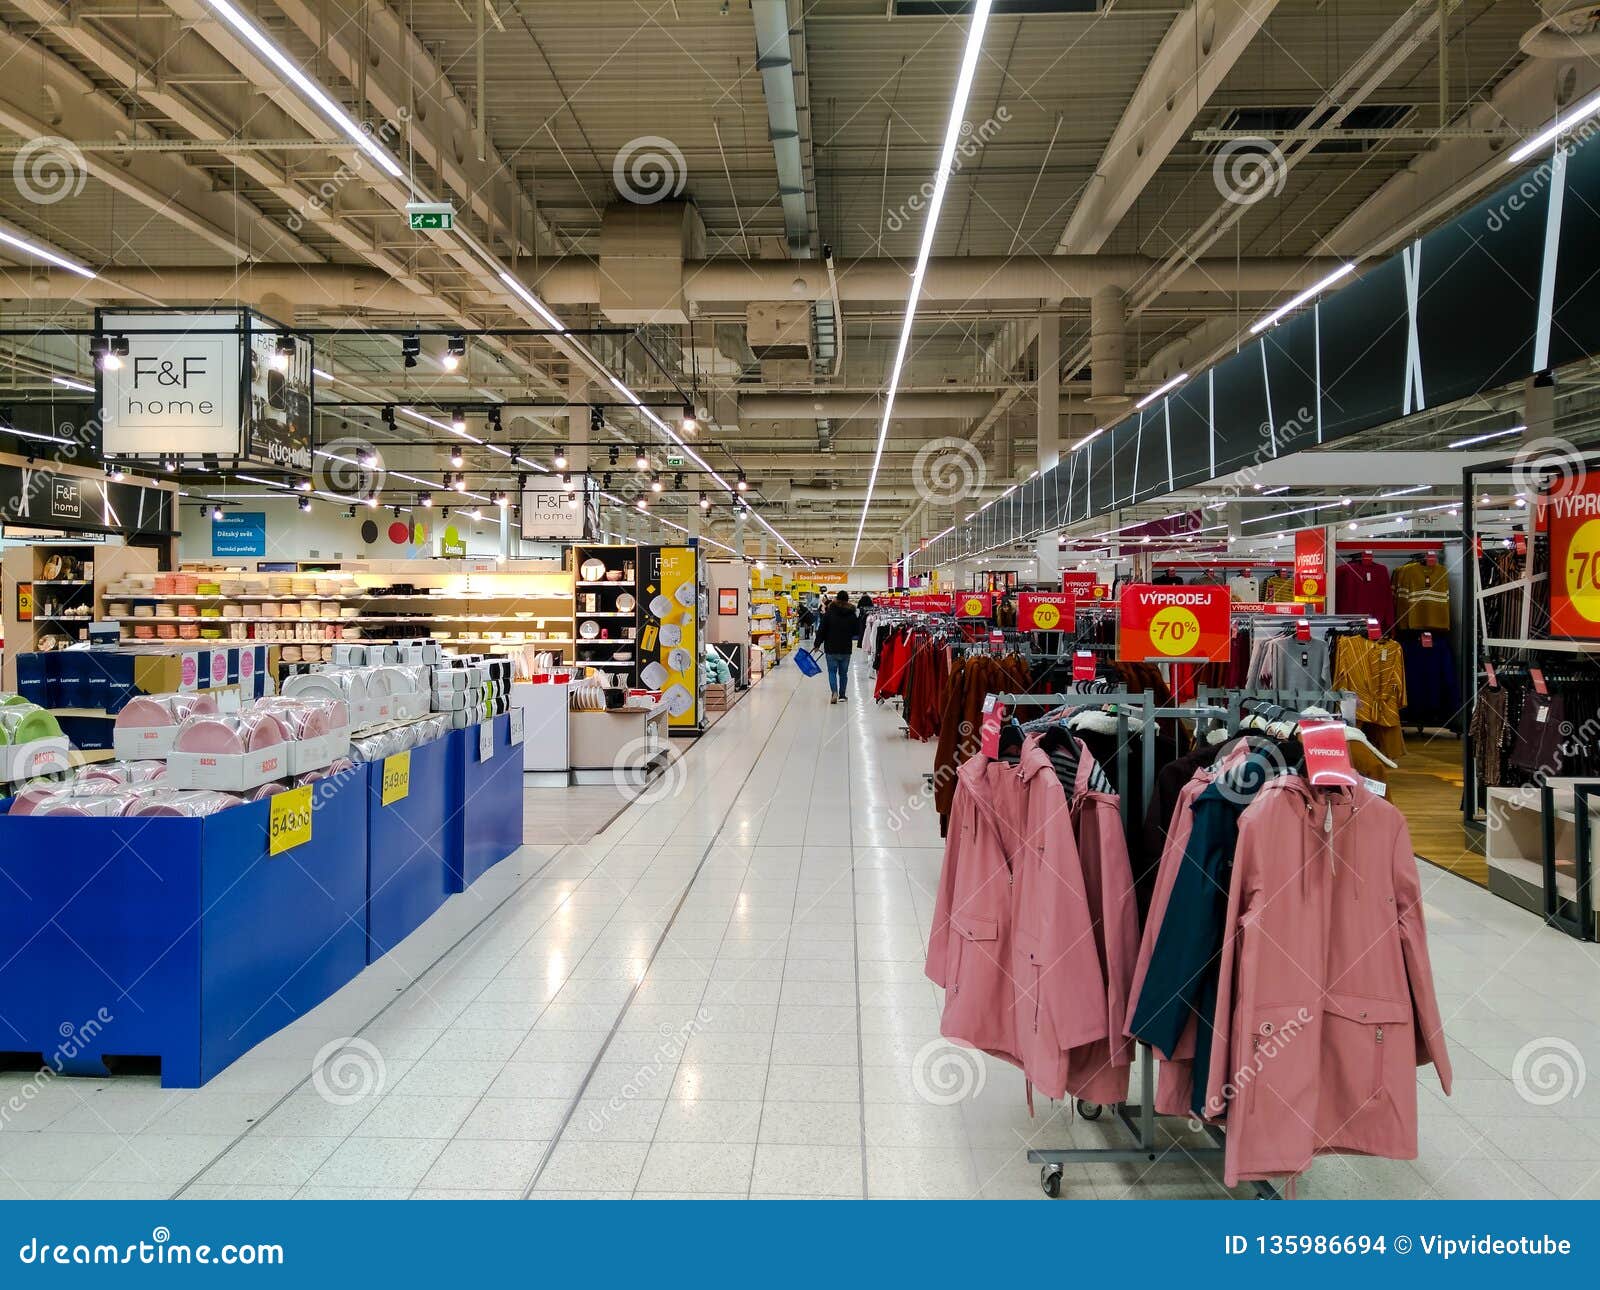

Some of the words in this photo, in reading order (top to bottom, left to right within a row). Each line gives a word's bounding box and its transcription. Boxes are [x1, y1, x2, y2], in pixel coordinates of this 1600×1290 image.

[134, 357, 207, 389] F&F
[128, 397, 214, 414] home
[56, 485, 77, 501] F&F
[54, 502, 79, 513] home
[537, 495, 569, 508] F&F
[1554, 491, 1600, 519] VÝPR
[534, 511, 573, 521] home
[655, 557, 680, 569] F&F
[1028, 595, 1066, 604] VÝPRODEJ
[1139, 590, 1212, 605] VÝPRODEJ
[1232, 604, 1265, 612] VÝPRODEJ
[1152, 620, 1197, 641] -70%
[34, 751, 56, 765] BASICS
[1308, 748, 1345, 757] VÝPRODEJ
[200, 758, 217, 766] BASICS
[272, 811, 310, 837] 549.00
